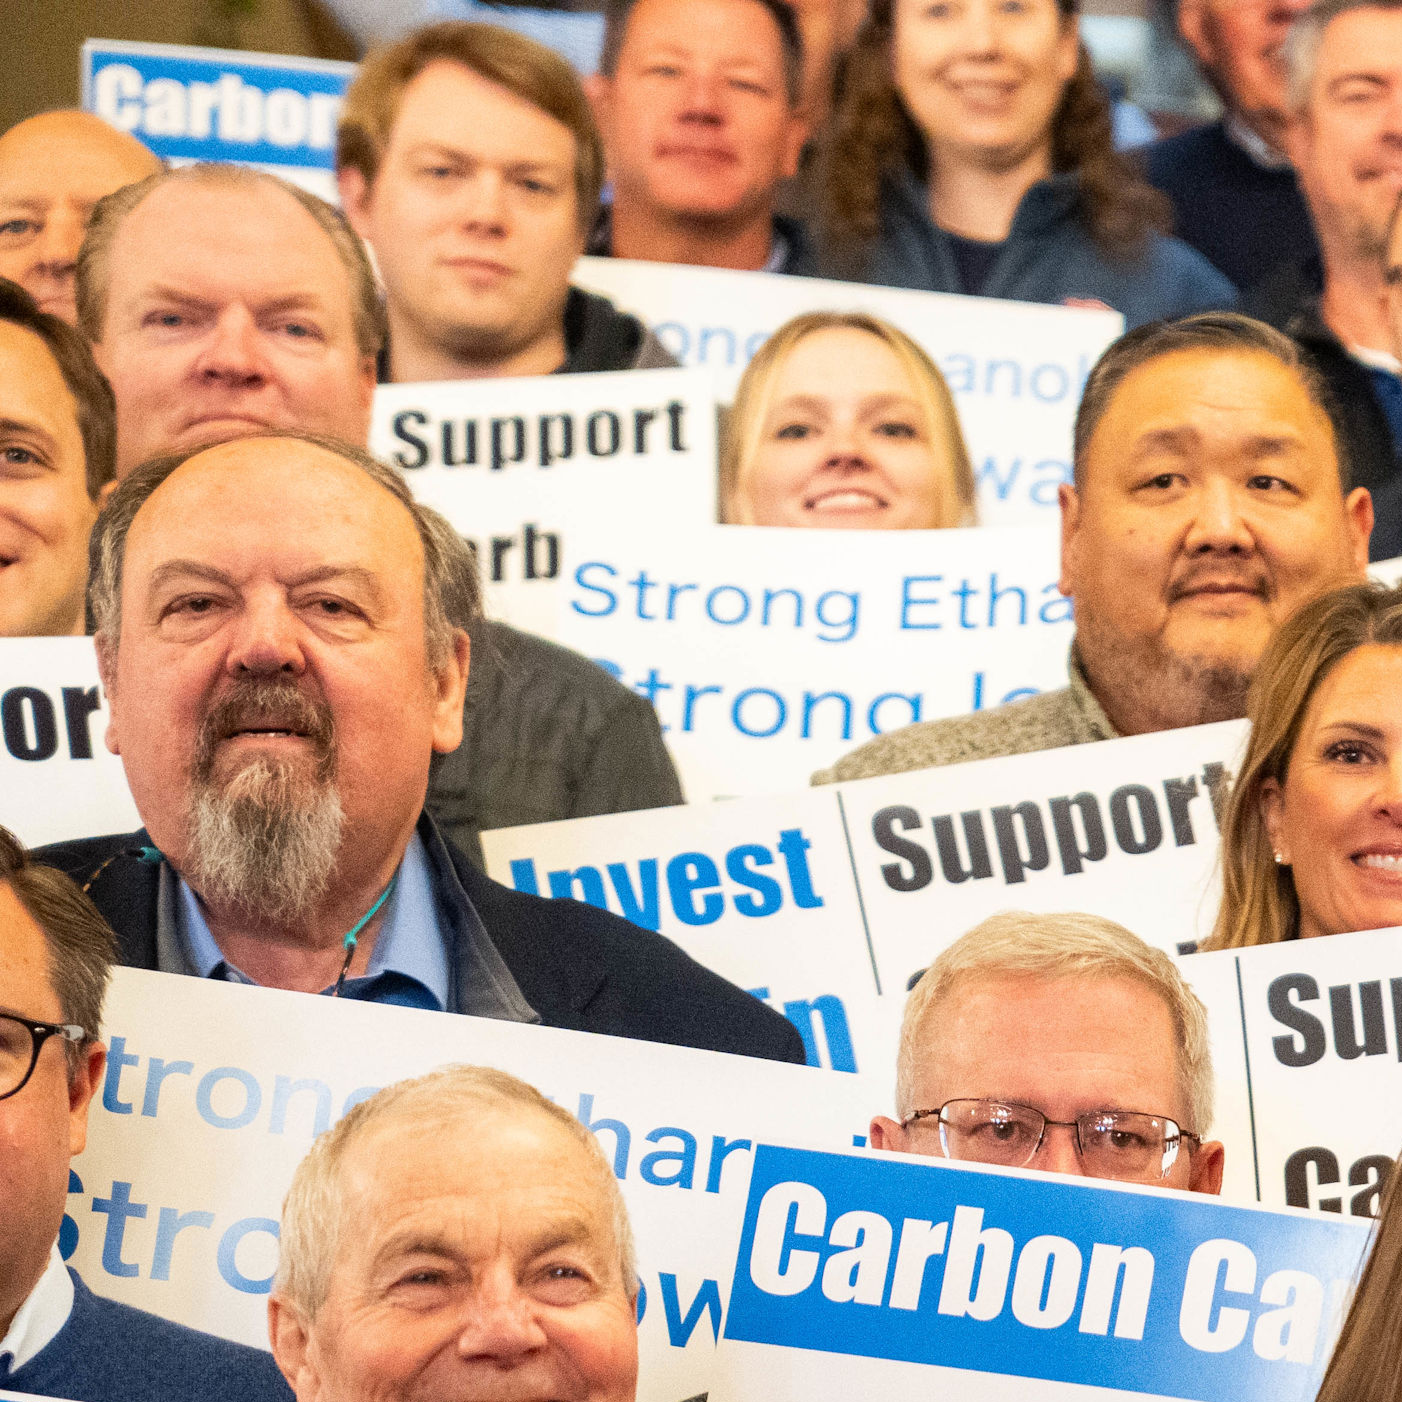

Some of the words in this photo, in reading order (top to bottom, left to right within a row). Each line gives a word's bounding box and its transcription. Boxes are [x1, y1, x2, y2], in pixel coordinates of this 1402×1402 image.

[392, 400, 690, 470] Support
[571, 561, 862, 643] Strong
[591, 657, 925, 741] trong
[748, 1180, 1154, 1342] Carbon
